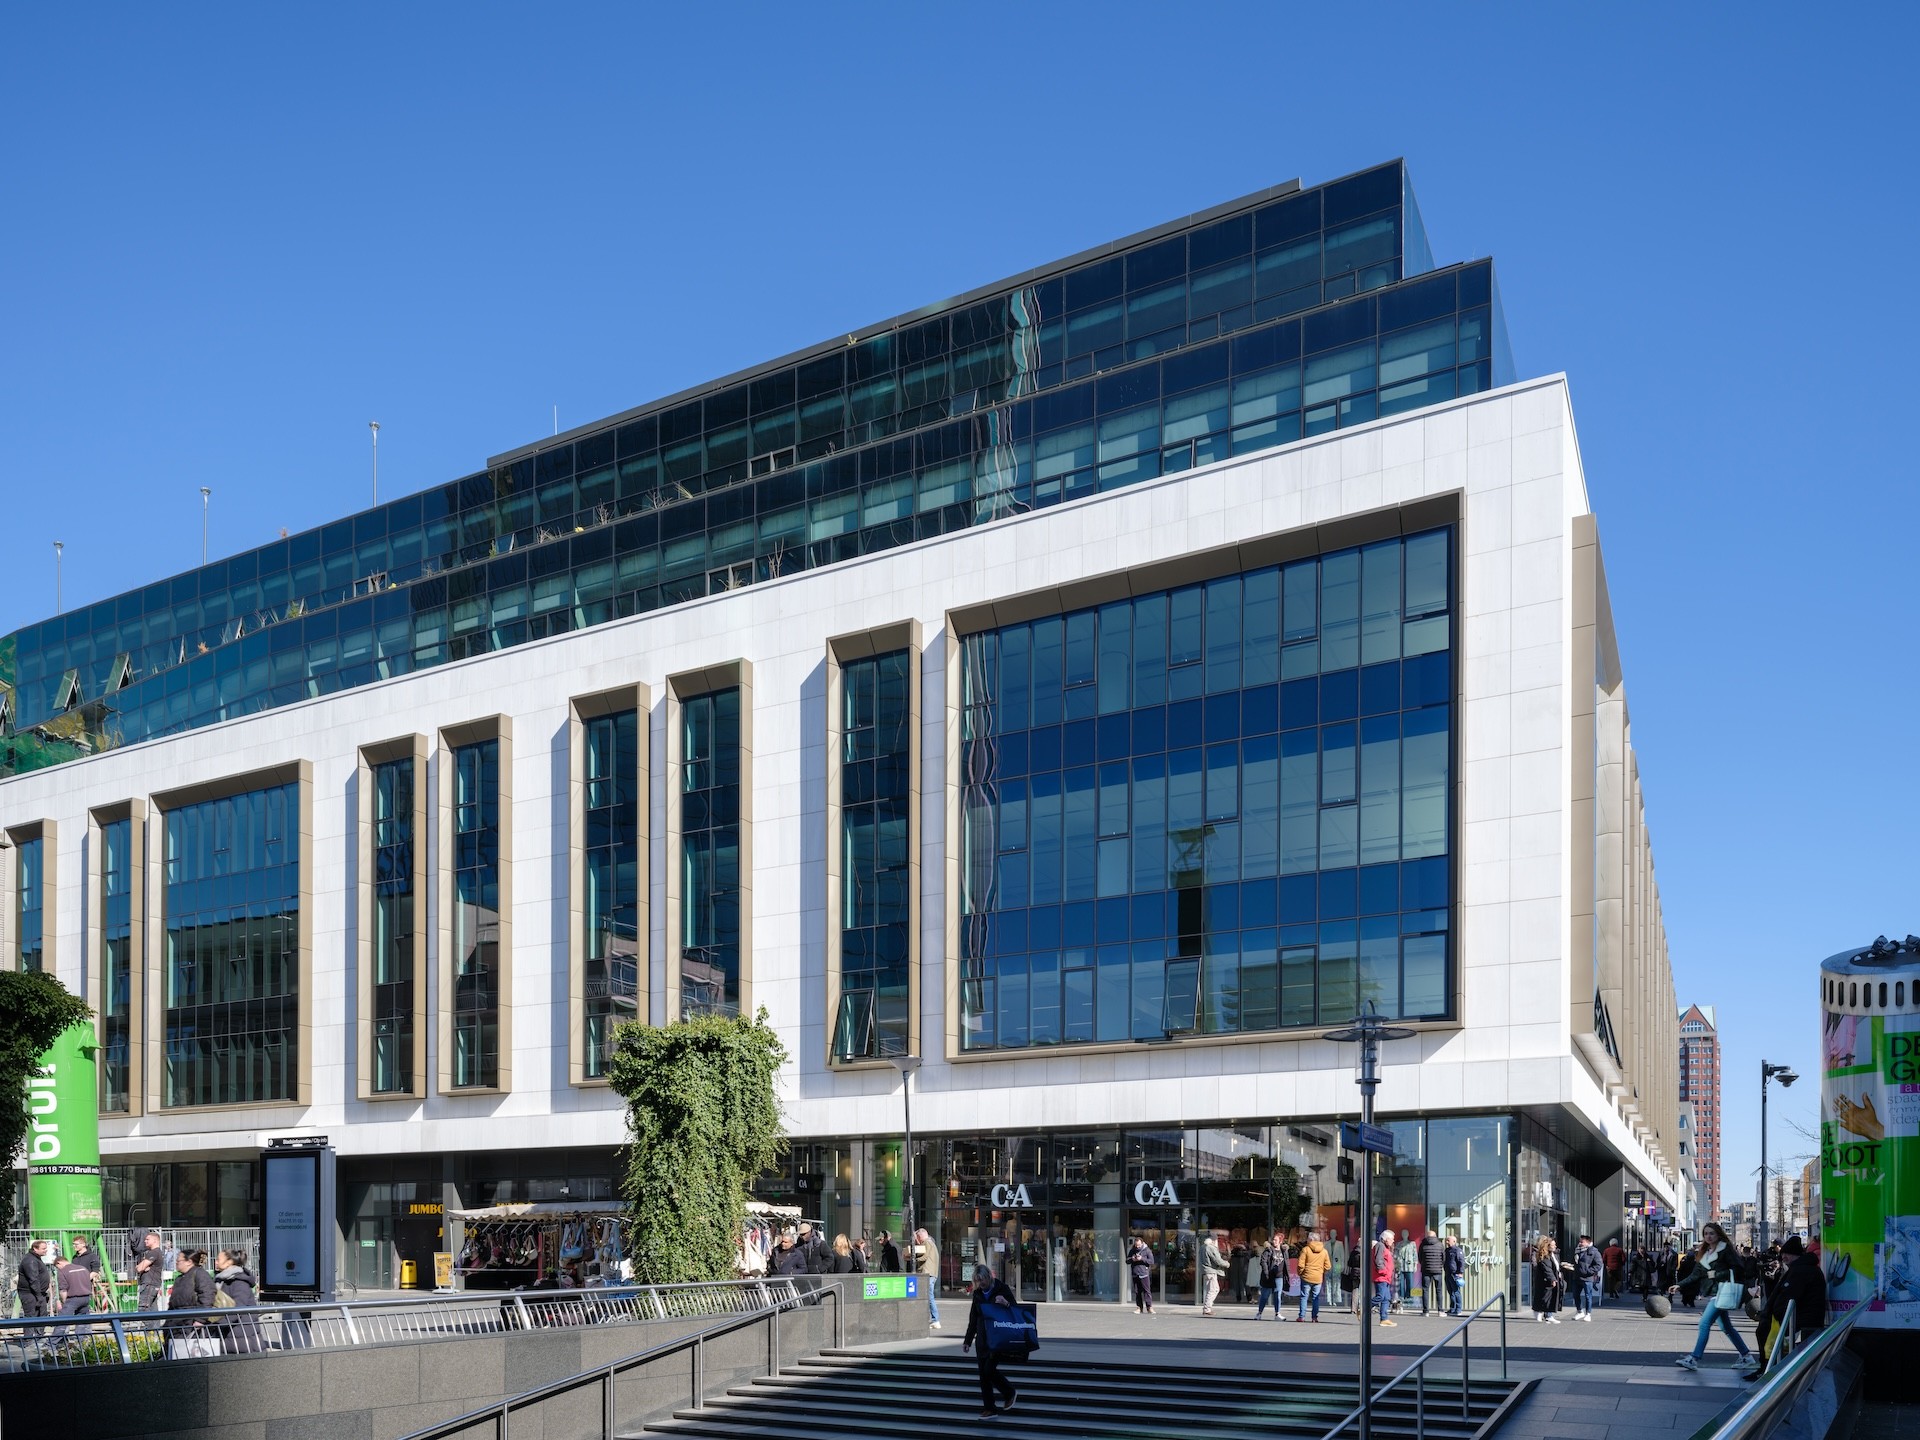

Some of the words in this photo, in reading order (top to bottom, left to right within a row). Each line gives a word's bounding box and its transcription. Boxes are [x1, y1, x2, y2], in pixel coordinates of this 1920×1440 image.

[1888, 1093, 1920, 1105] spac
[39, 1166, 58, 1174] 8118
[990, 1183, 1033, 1208] C&A
[1134, 1179, 1181, 1206] C&A
[409, 1203, 443, 1215] JUMBO
[1438, 1203, 1495, 1240] Hi!
